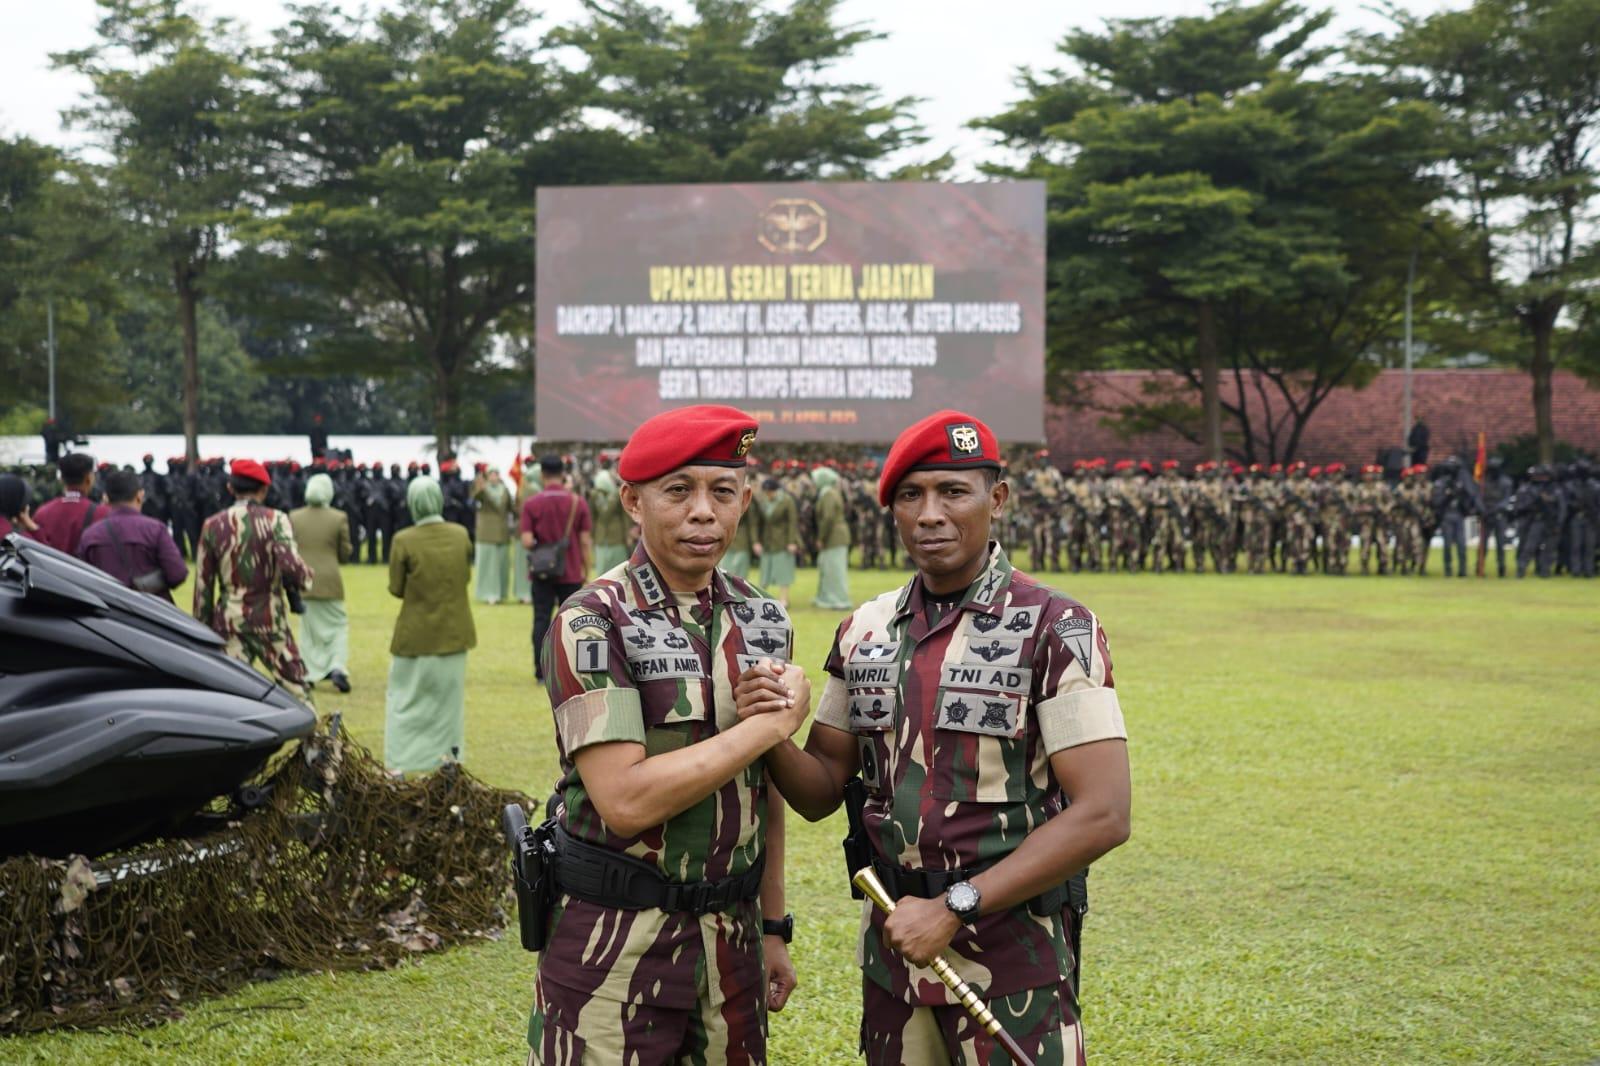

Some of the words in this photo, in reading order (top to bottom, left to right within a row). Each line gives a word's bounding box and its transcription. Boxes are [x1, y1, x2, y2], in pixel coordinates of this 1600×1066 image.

[650, 265, 728, 301] UPACARA
[731, 264, 786, 301] SERAH
[790, 264, 855, 300] TERIMA
[858, 264, 934, 300] JABATAN
[954, 302, 1021, 333] KOPASSUS
[872, 336, 937, 366] KOPASSUS
[847, 368, 913, 399] KOPASSUS
[572, 616, 610, 630] KOMANDO
[1055, 619, 1090, 632] KOPASSUS
[586, 642, 599, 669] 1
[674, 657, 700, 673] AMIR
[849, 667, 890, 683] AMRIL
[949, 667, 981, 683] TNI
[989, 670, 1021, 688] AD
